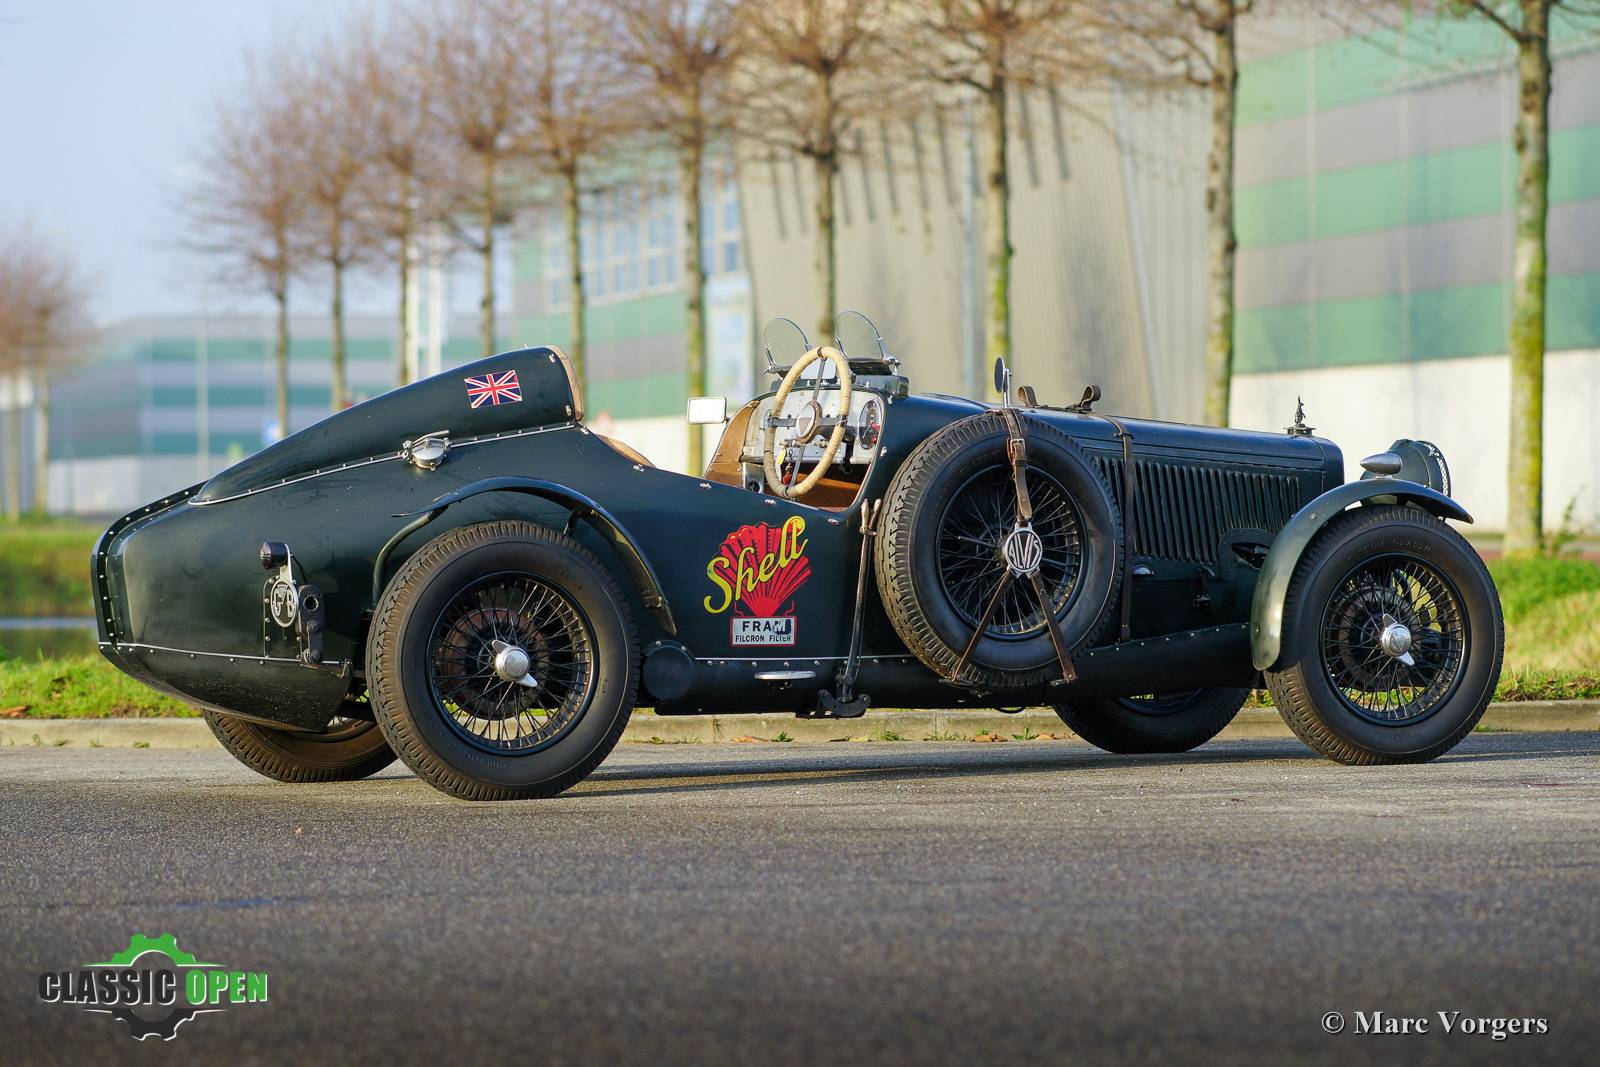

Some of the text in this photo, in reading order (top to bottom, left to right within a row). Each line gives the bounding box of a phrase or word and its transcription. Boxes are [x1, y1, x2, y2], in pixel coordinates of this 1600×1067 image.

[703, 515, 808, 613] Shell
[1008, 532, 1041, 569] ALVIS
[273, 588, 296, 617] GB
[735, 634, 792, 642] FILCRON FILTER
